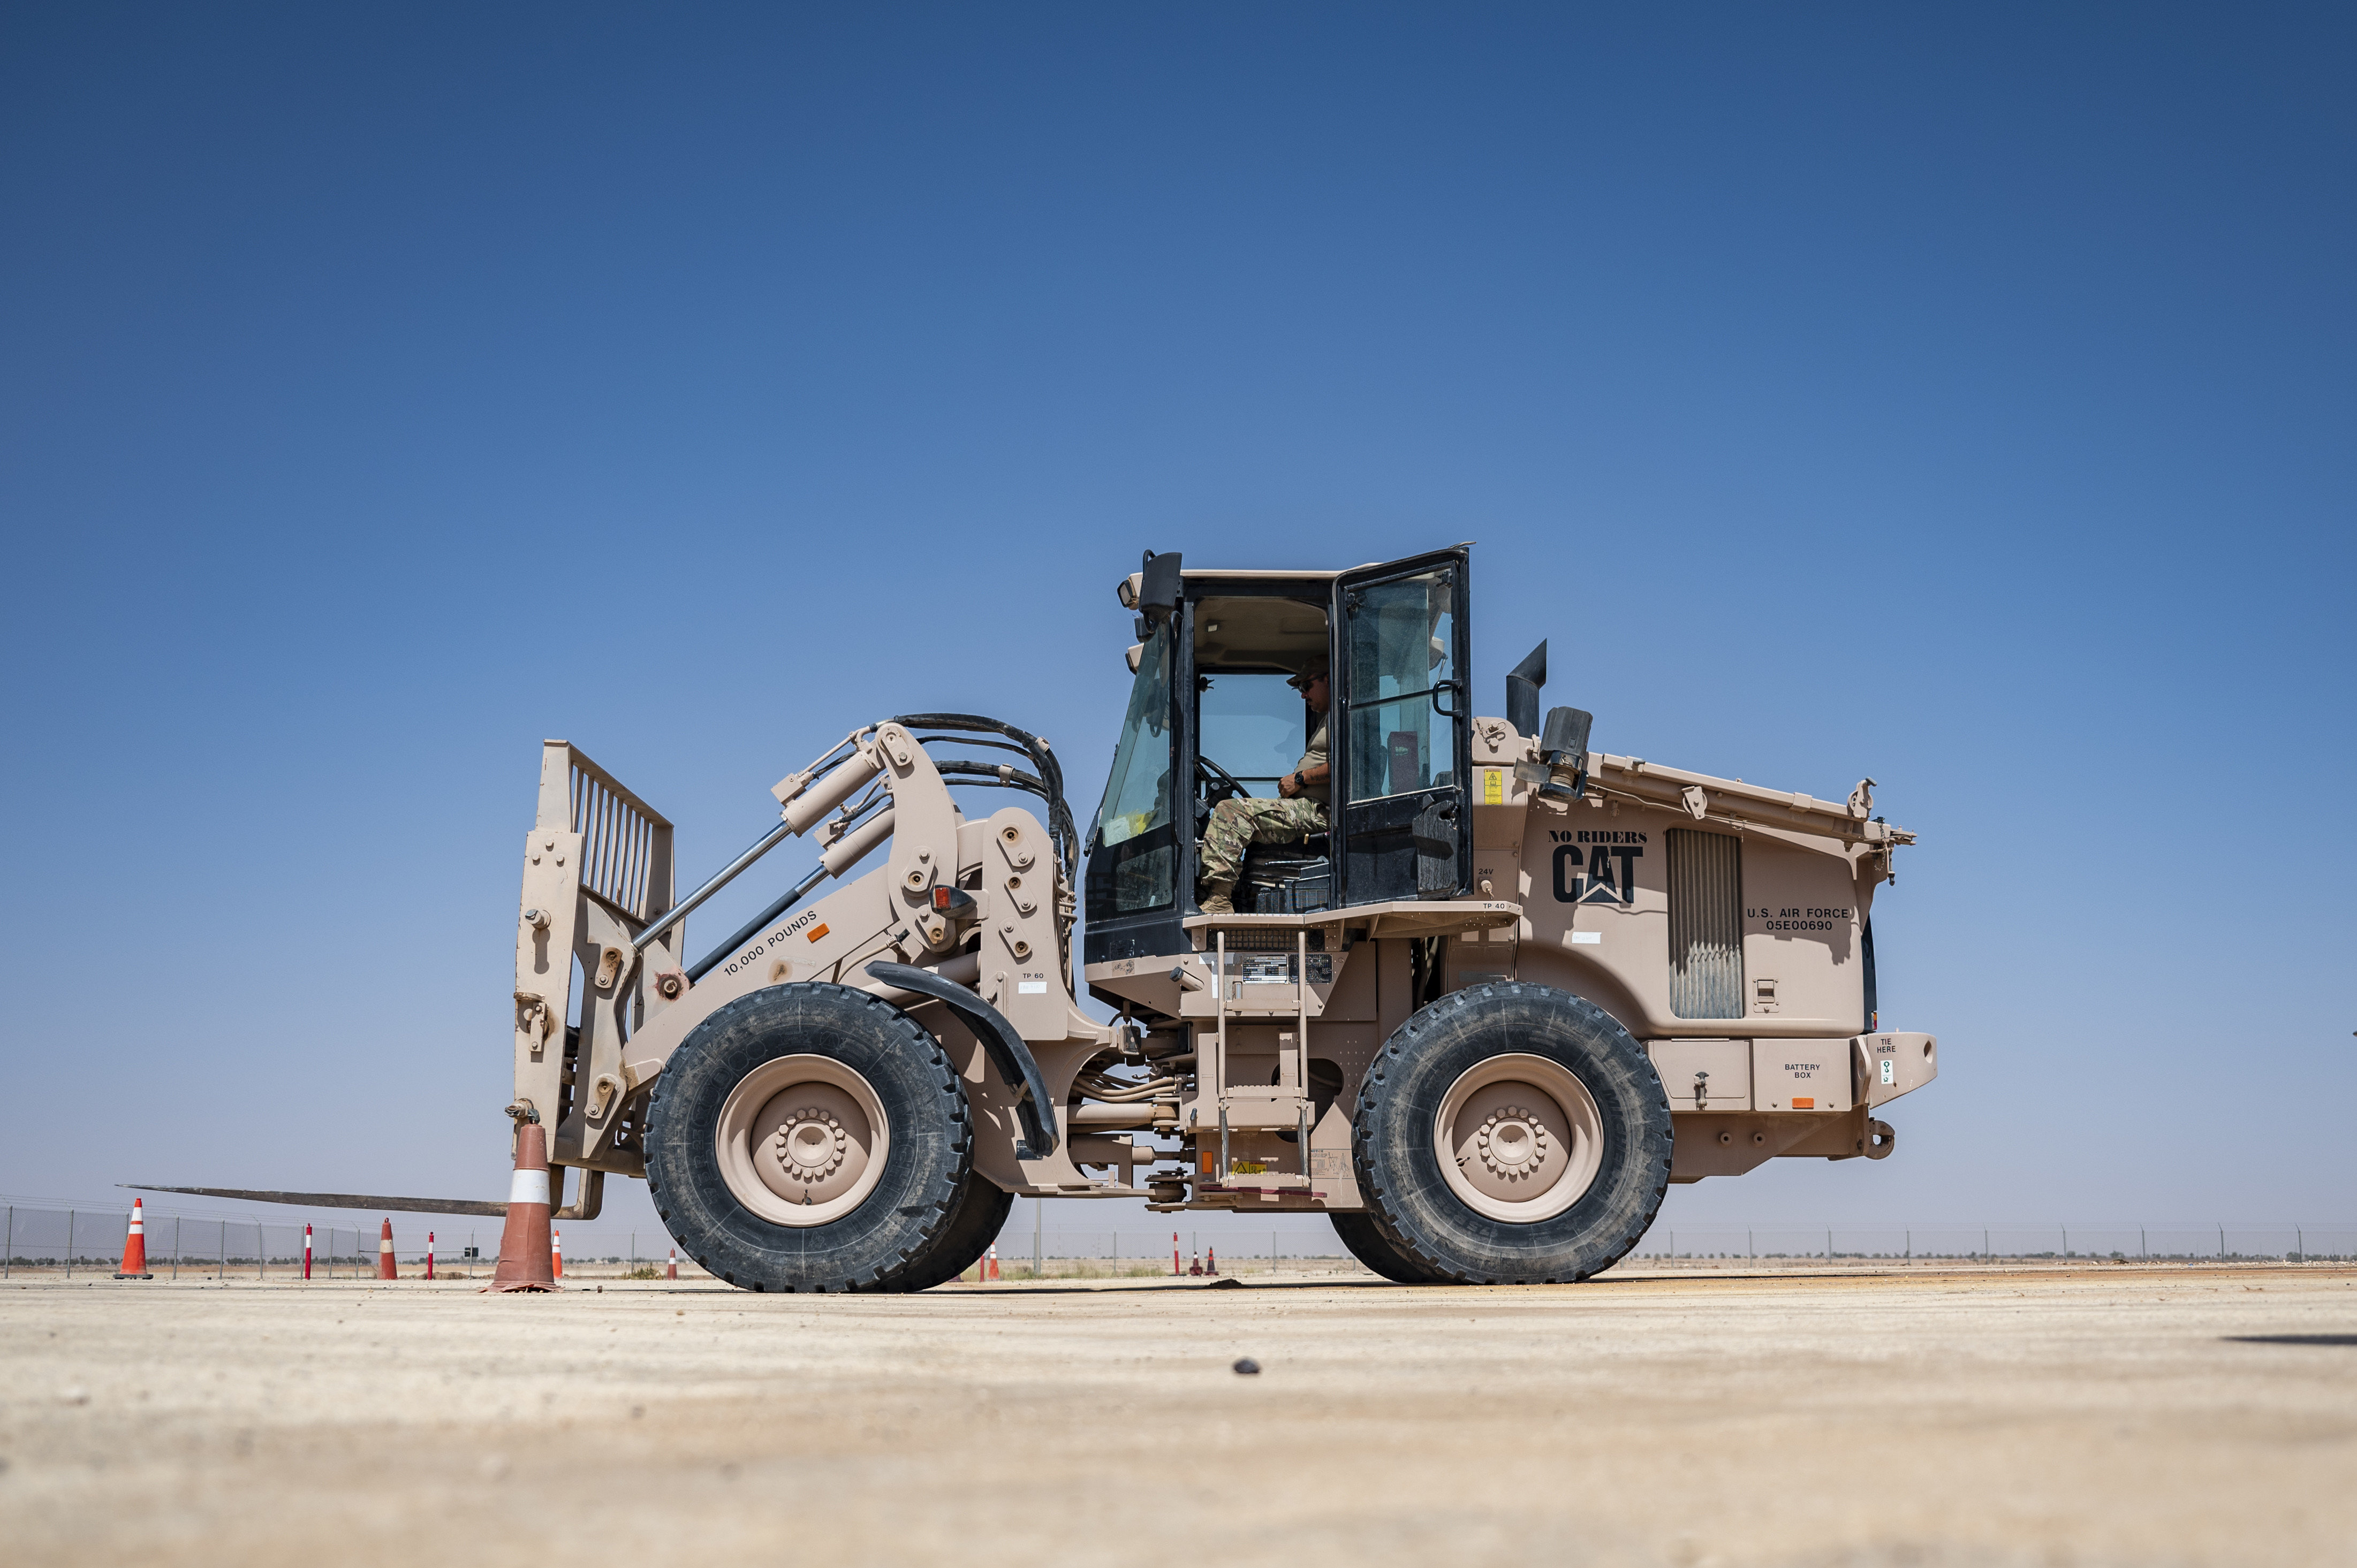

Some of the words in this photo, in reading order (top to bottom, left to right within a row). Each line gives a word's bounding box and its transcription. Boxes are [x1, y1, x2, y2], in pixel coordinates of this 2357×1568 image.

[1548, 830, 1572, 843] NO
[1577, 831, 1647, 844] RIDERS
[1552, 844, 1644, 904] CAT
[1747, 908, 1773, 918] U.S.
[1779, 908, 1800, 918] AIR
[1807, 908, 1848, 918] FORCE
[1766, 920, 1832, 931] 05E00690
[724, 946, 764, 976] 10,000
[767, 910, 817, 947] POUNDS
[1877, 1045, 1896, 1054] HERE
[1598, 1087, 1627, 1198] MICHELIN
[833, 1100, 915, 1246] MICHELIN
